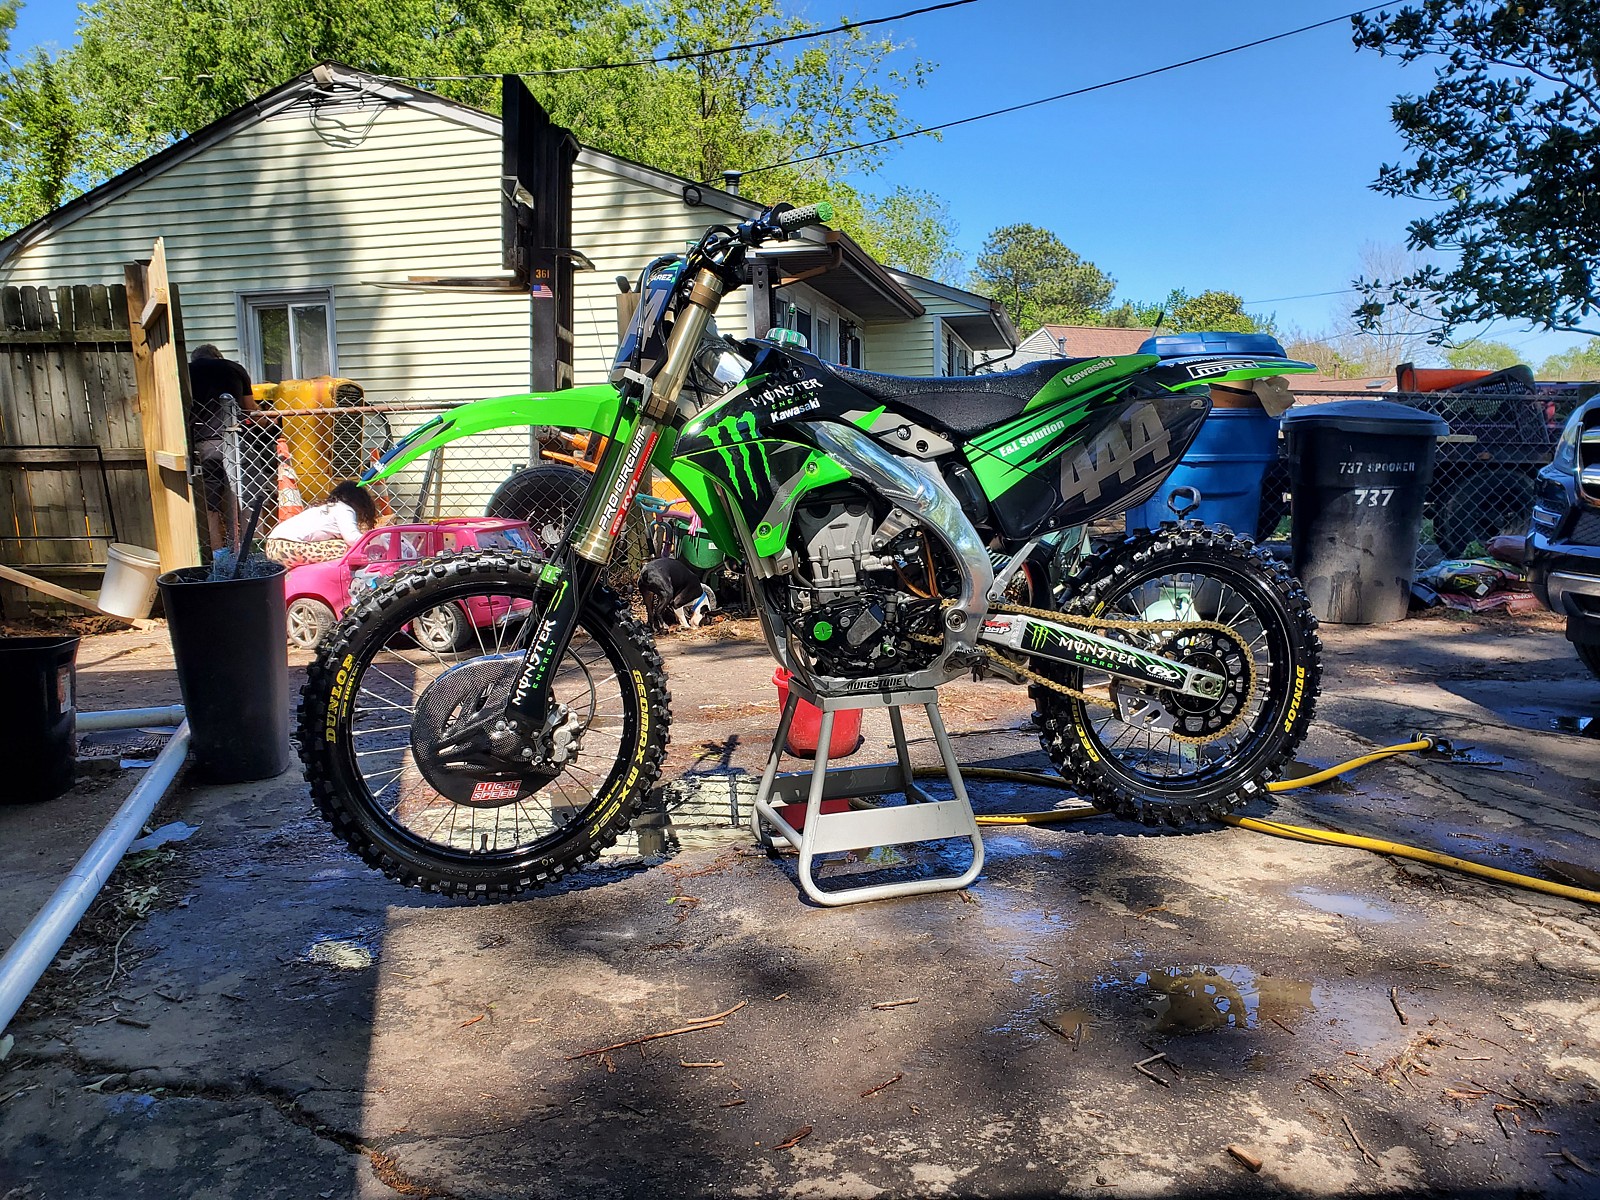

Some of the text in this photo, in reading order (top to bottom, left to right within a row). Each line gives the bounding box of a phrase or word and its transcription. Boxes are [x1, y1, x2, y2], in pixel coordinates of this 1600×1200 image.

[535, 269, 550, 279] 361
[1062, 357, 1117, 388] Kawasaki
[749, 378, 823, 407] MONSTER
[771, 391, 814, 410] ENERGY
[770, 397, 821, 423] Kawasaki
[998, 419, 1065, 458] E&L Solution
[1060, 401, 1172, 504] 444
[599, 428, 646, 531] PRO CIRCUIT
[1339, 462, 1363, 474] 737
[1354, 489, 1395, 507] 737
[511, 619, 557, 706] MONSTER
[532, 640, 556, 689] ENERGY
[1058, 636, 1138, 668] MONSTER
[1075, 654, 1121, 671] ENERGY
[326, 653, 354, 744] DUNLOP
[1284, 664, 1305, 733] DUNLOP
[472, 790, 518, 800] SPEED
[476, 781, 521, 791] LIGHT
